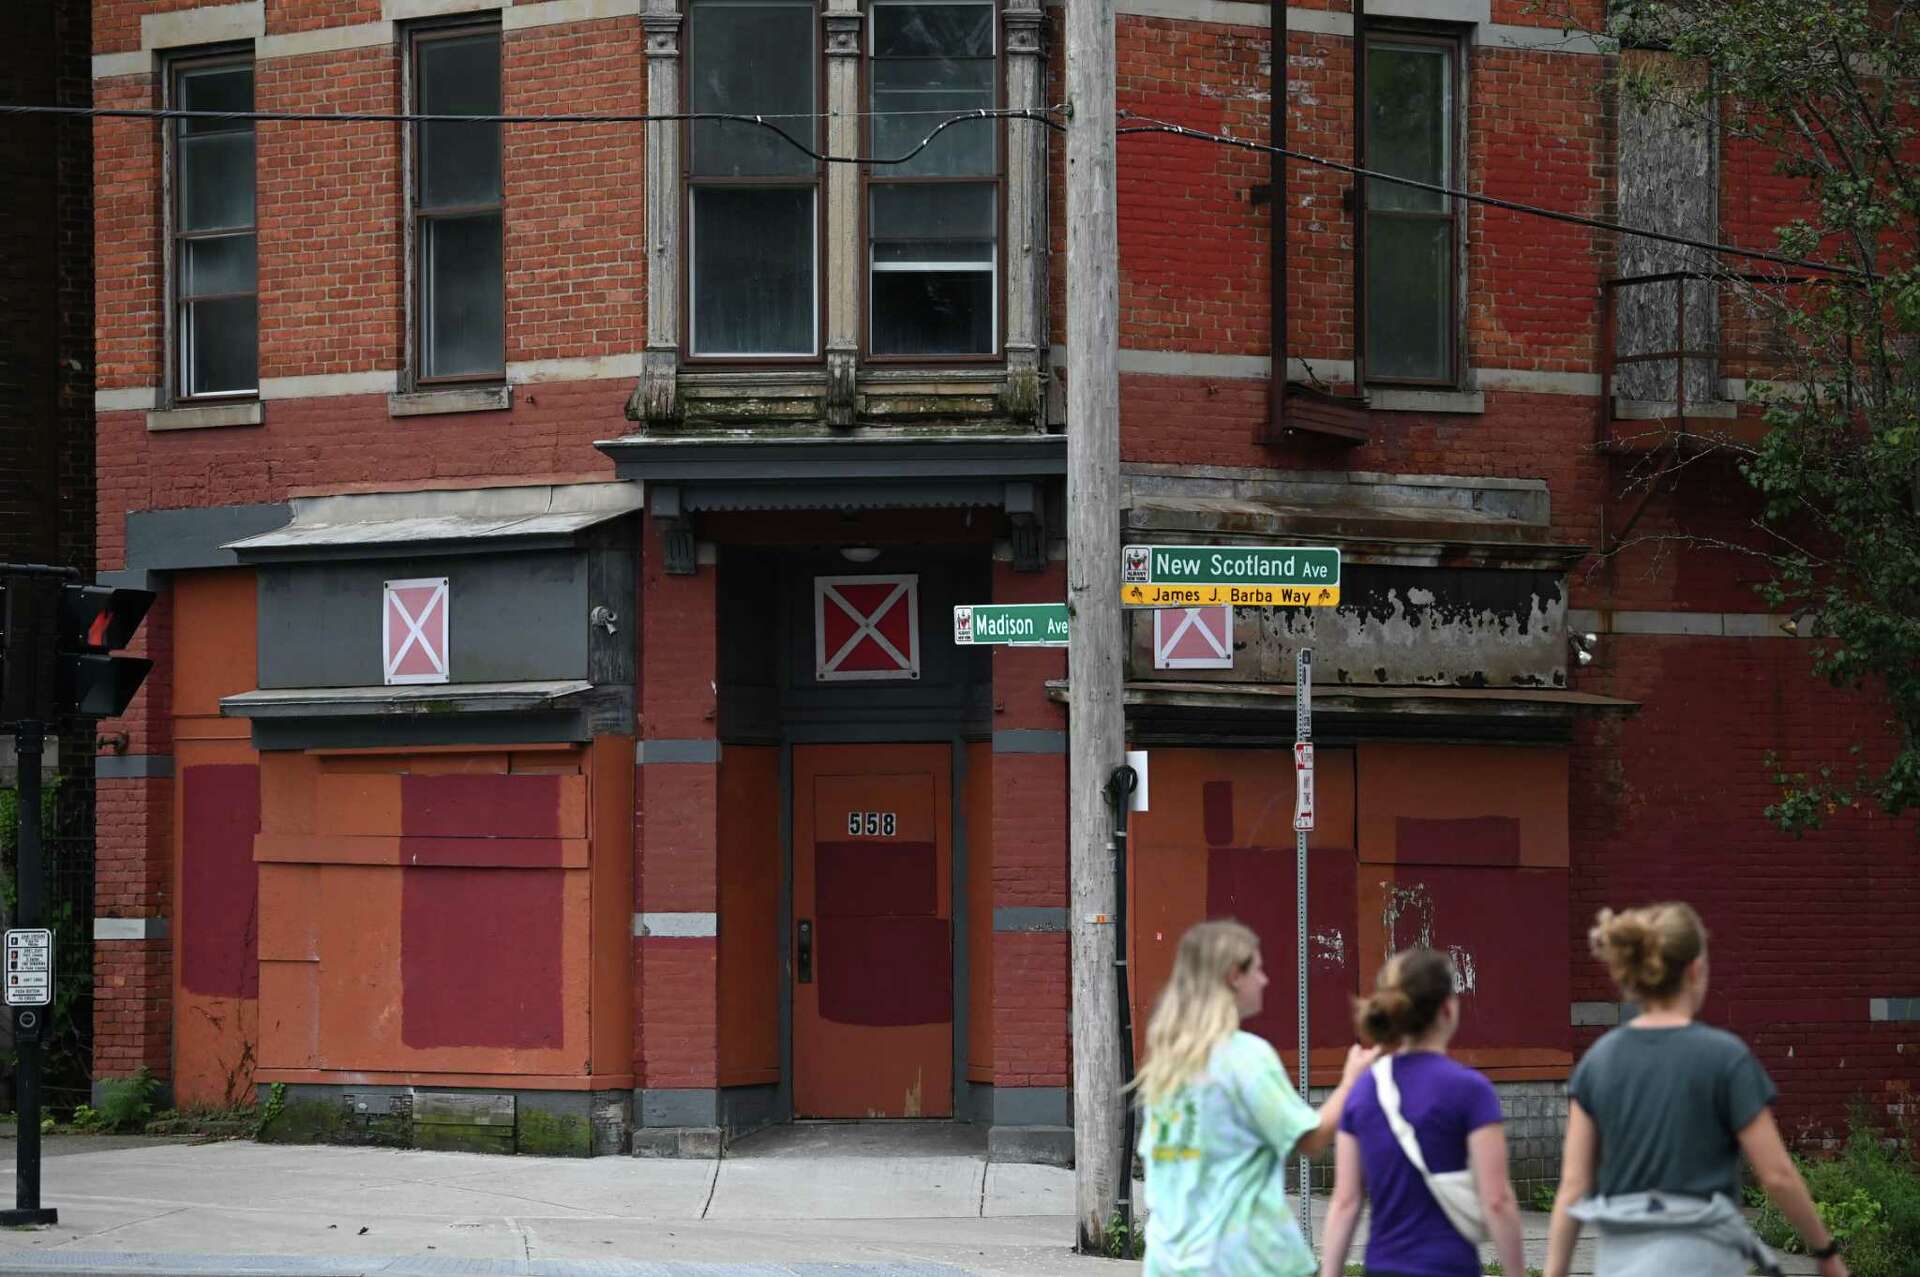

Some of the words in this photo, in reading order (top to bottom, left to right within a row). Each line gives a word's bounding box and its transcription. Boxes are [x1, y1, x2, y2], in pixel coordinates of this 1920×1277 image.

[1157, 553, 1201, 575] New
[1210, 554, 1295, 576] Scotland
[1302, 561, 1328, 578] Ave
[1152, 587, 1200, 602] James
[1208, 587, 1221, 602] J.
[1230, 588, 1272, 603] Barba
[1281, 588, 1311, 606] Way
[976, 613, 1034, 636] Madison
[1047, 617, 1068, 634] Ave
[849, 813, 894, 835] 558
